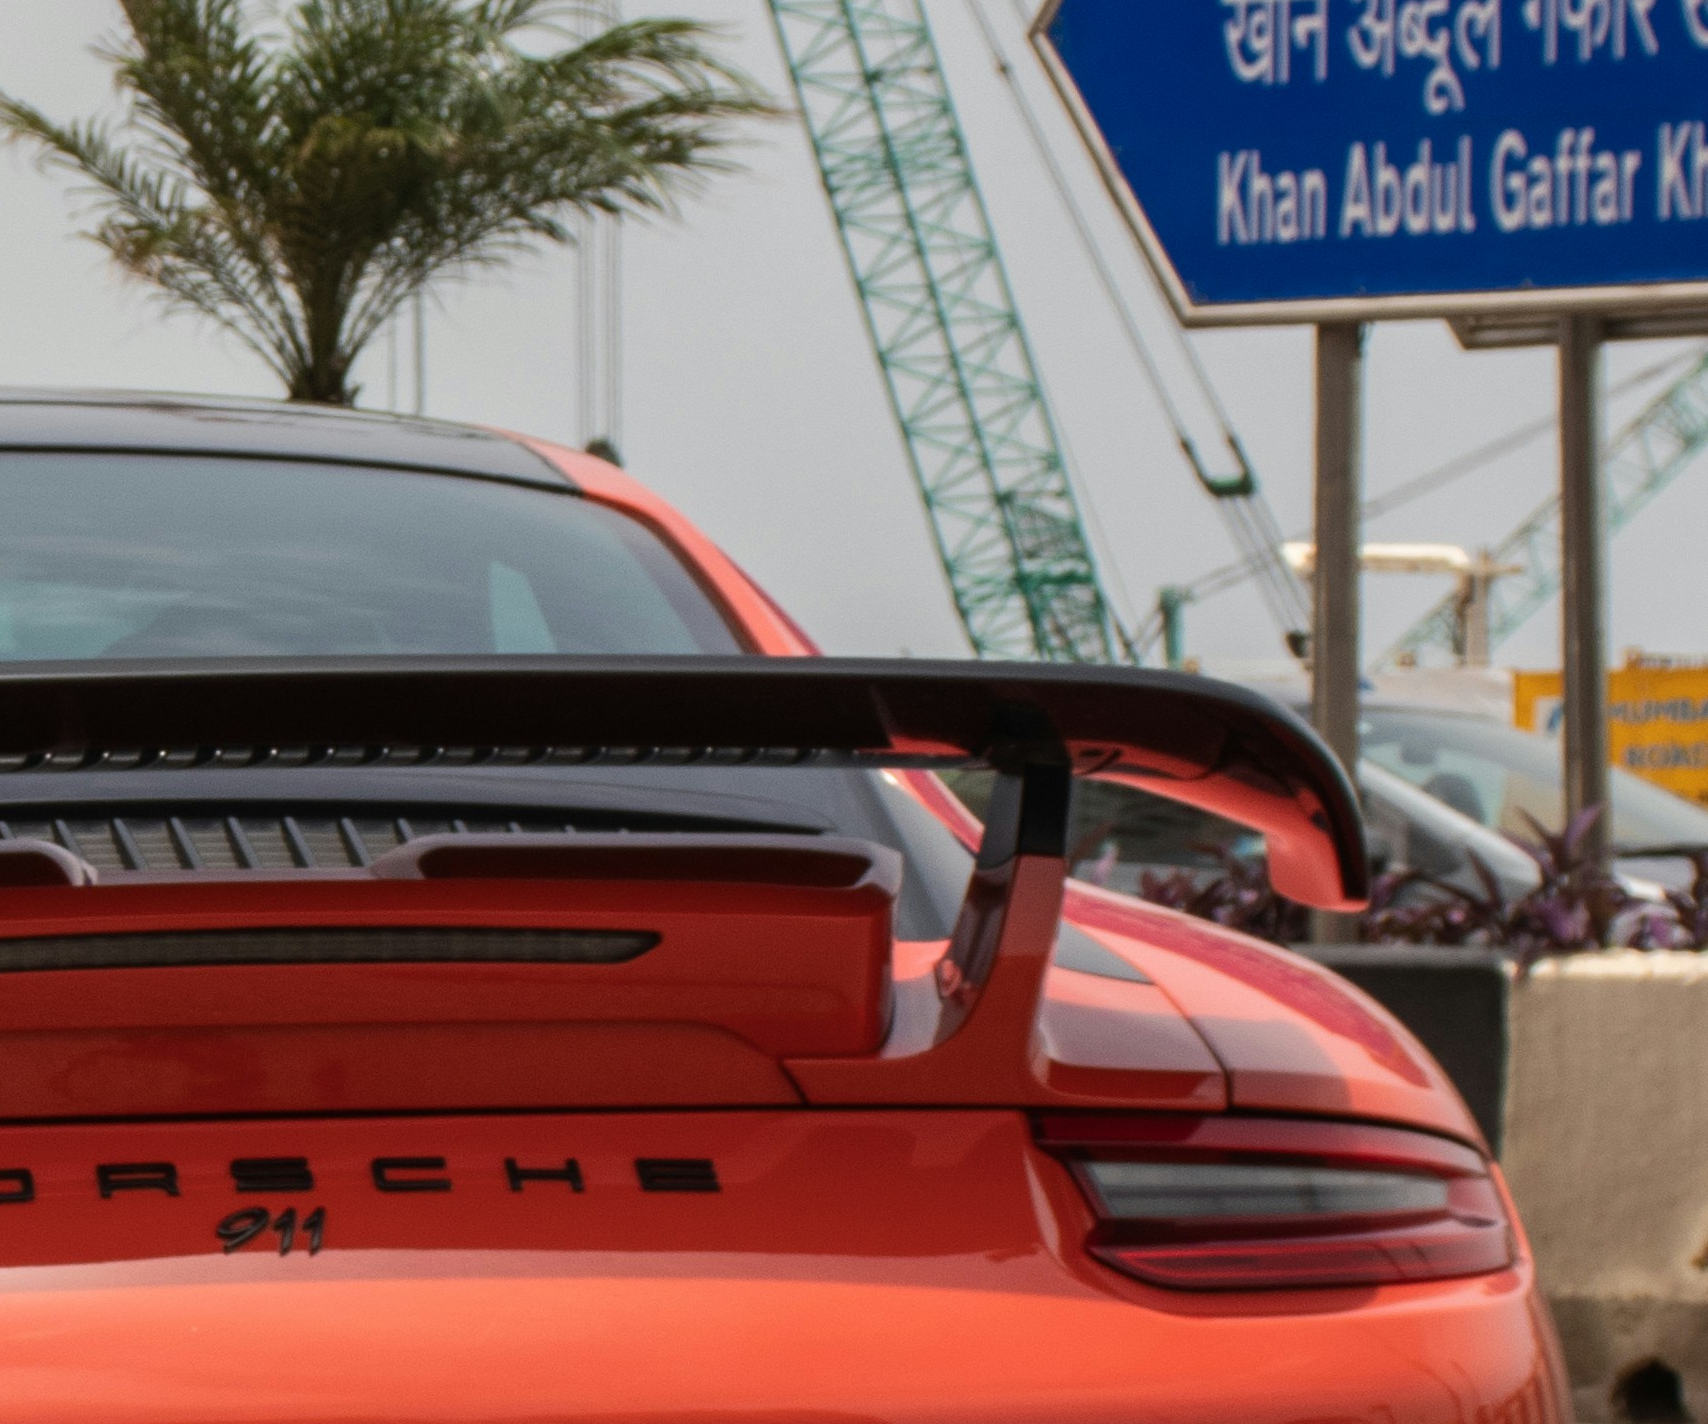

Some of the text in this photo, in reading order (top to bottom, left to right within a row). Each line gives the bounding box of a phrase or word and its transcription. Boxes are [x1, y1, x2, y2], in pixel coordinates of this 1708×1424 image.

[1217, 148, 1327, 246] Khan
[1338, 133, 1476, 238] Abdul
[1491, 124, 1642, 232] Gaffar
[215, 1206, 326, 1257] 911
